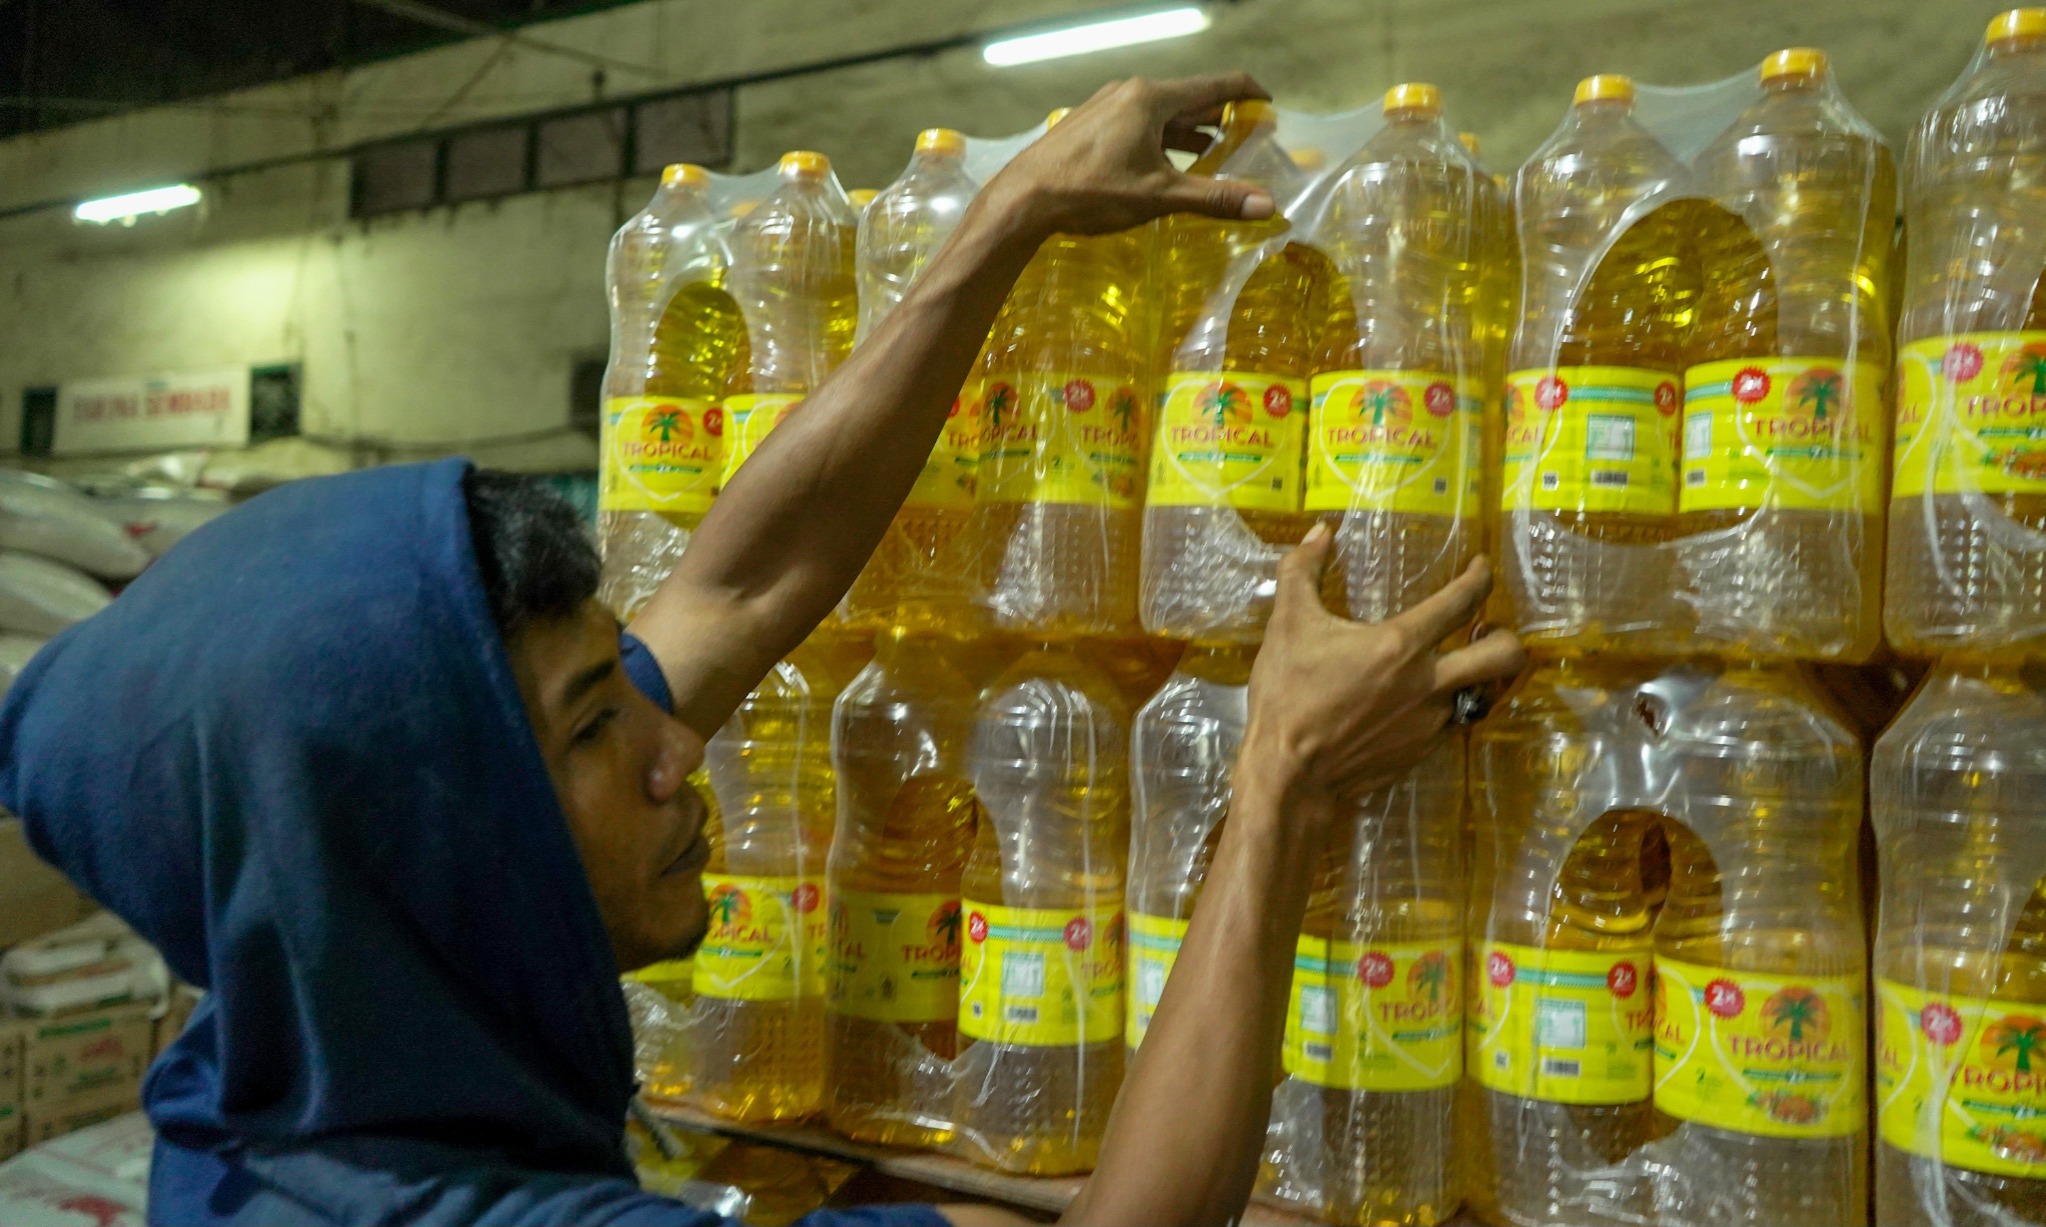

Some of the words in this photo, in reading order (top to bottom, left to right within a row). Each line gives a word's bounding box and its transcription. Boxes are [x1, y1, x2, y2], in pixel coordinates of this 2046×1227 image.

[1171, 425, 1274, 448] TROPICAL
[1328, 426, 1437, 449] TROPICAL
[622, 440, 714, 461] TROPICAL
